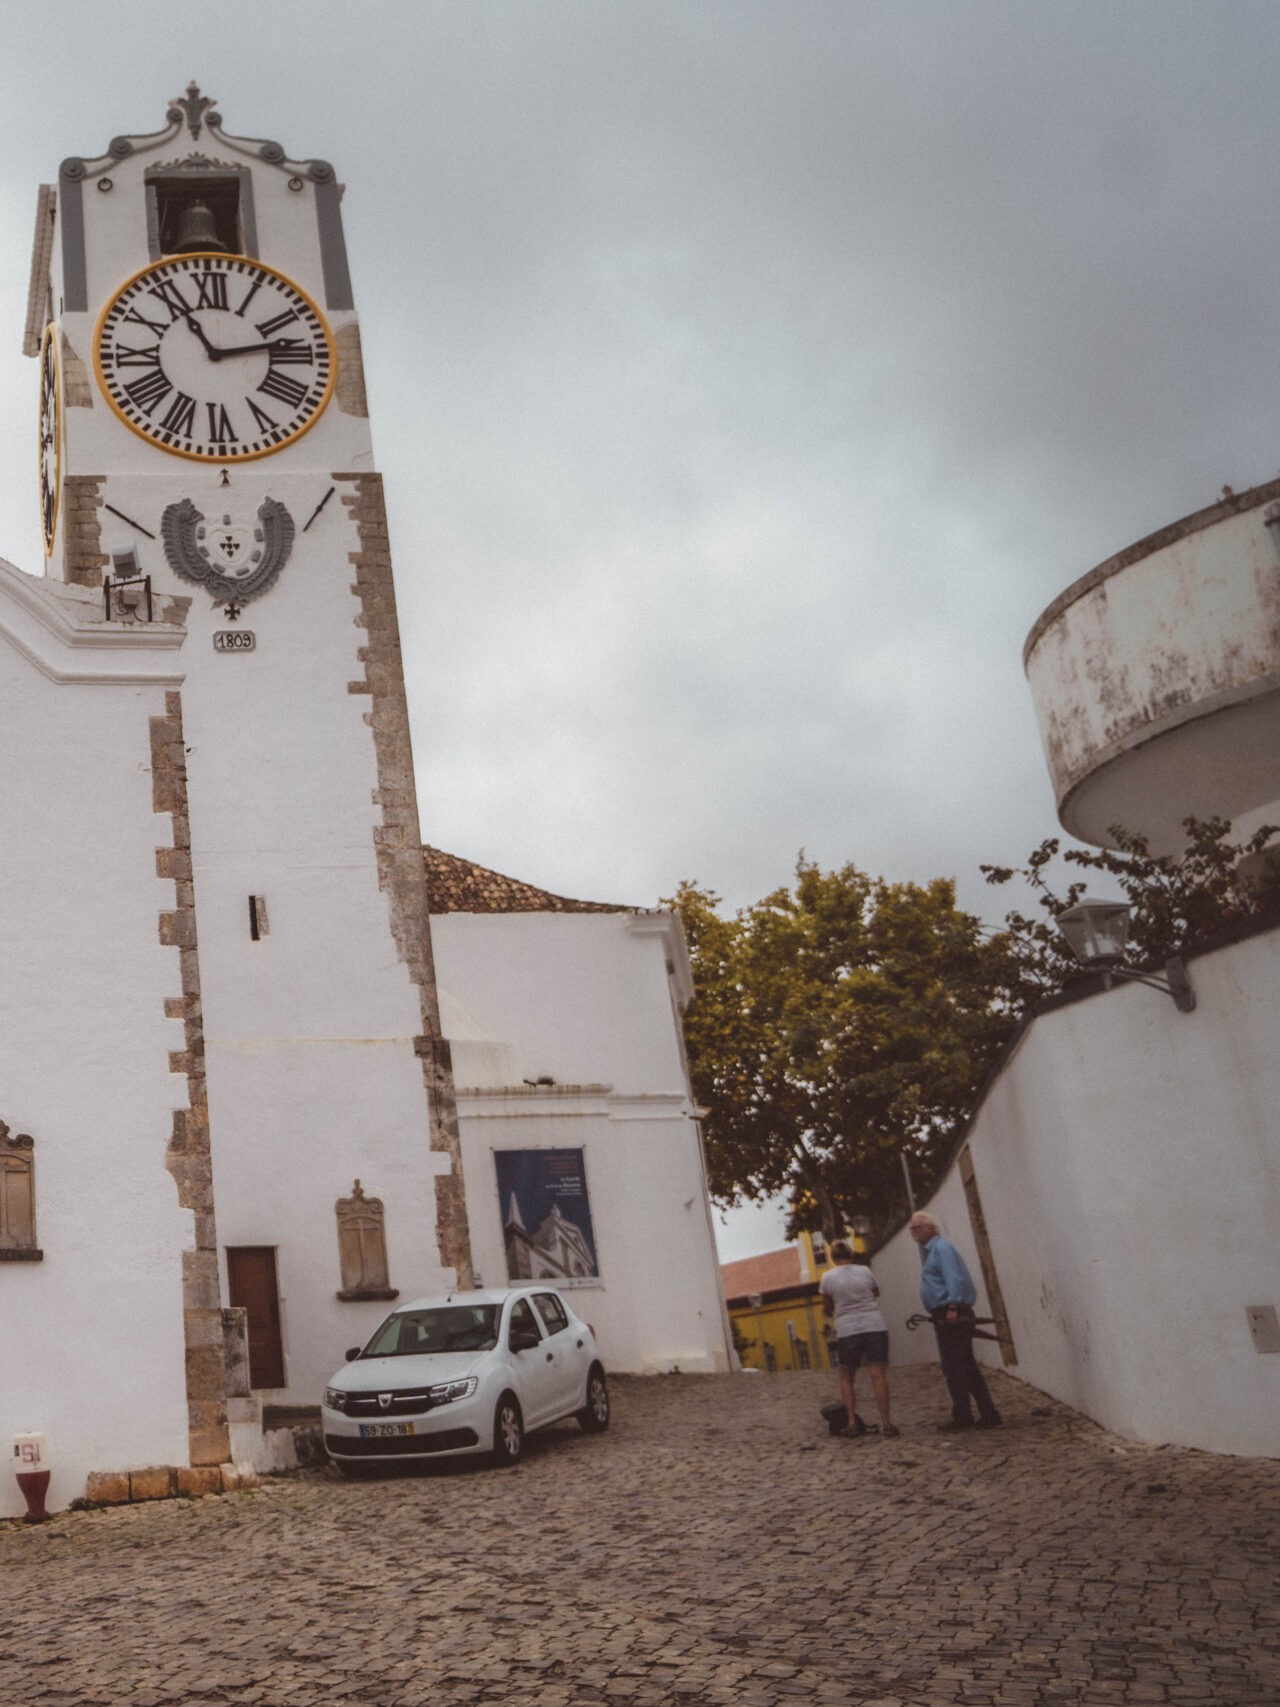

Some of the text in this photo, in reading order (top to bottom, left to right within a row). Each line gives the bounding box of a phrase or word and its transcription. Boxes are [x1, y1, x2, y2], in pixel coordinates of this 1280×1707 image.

[148, 279, 195, 322] XI
[189, 272, 230, 311] XII
[234, 281, 262, 318] I
[123, 307, 170, 340] X
[254, 308, 300, 339] II
[115, 343, 161, 368] IX
[269, 344, 313, 366] III
[158, 391, 197, 439] VII
[205, 402, 239, 443] VI
[245, 396, 280, 434] V
[217, 633, 251, 648] 1809
